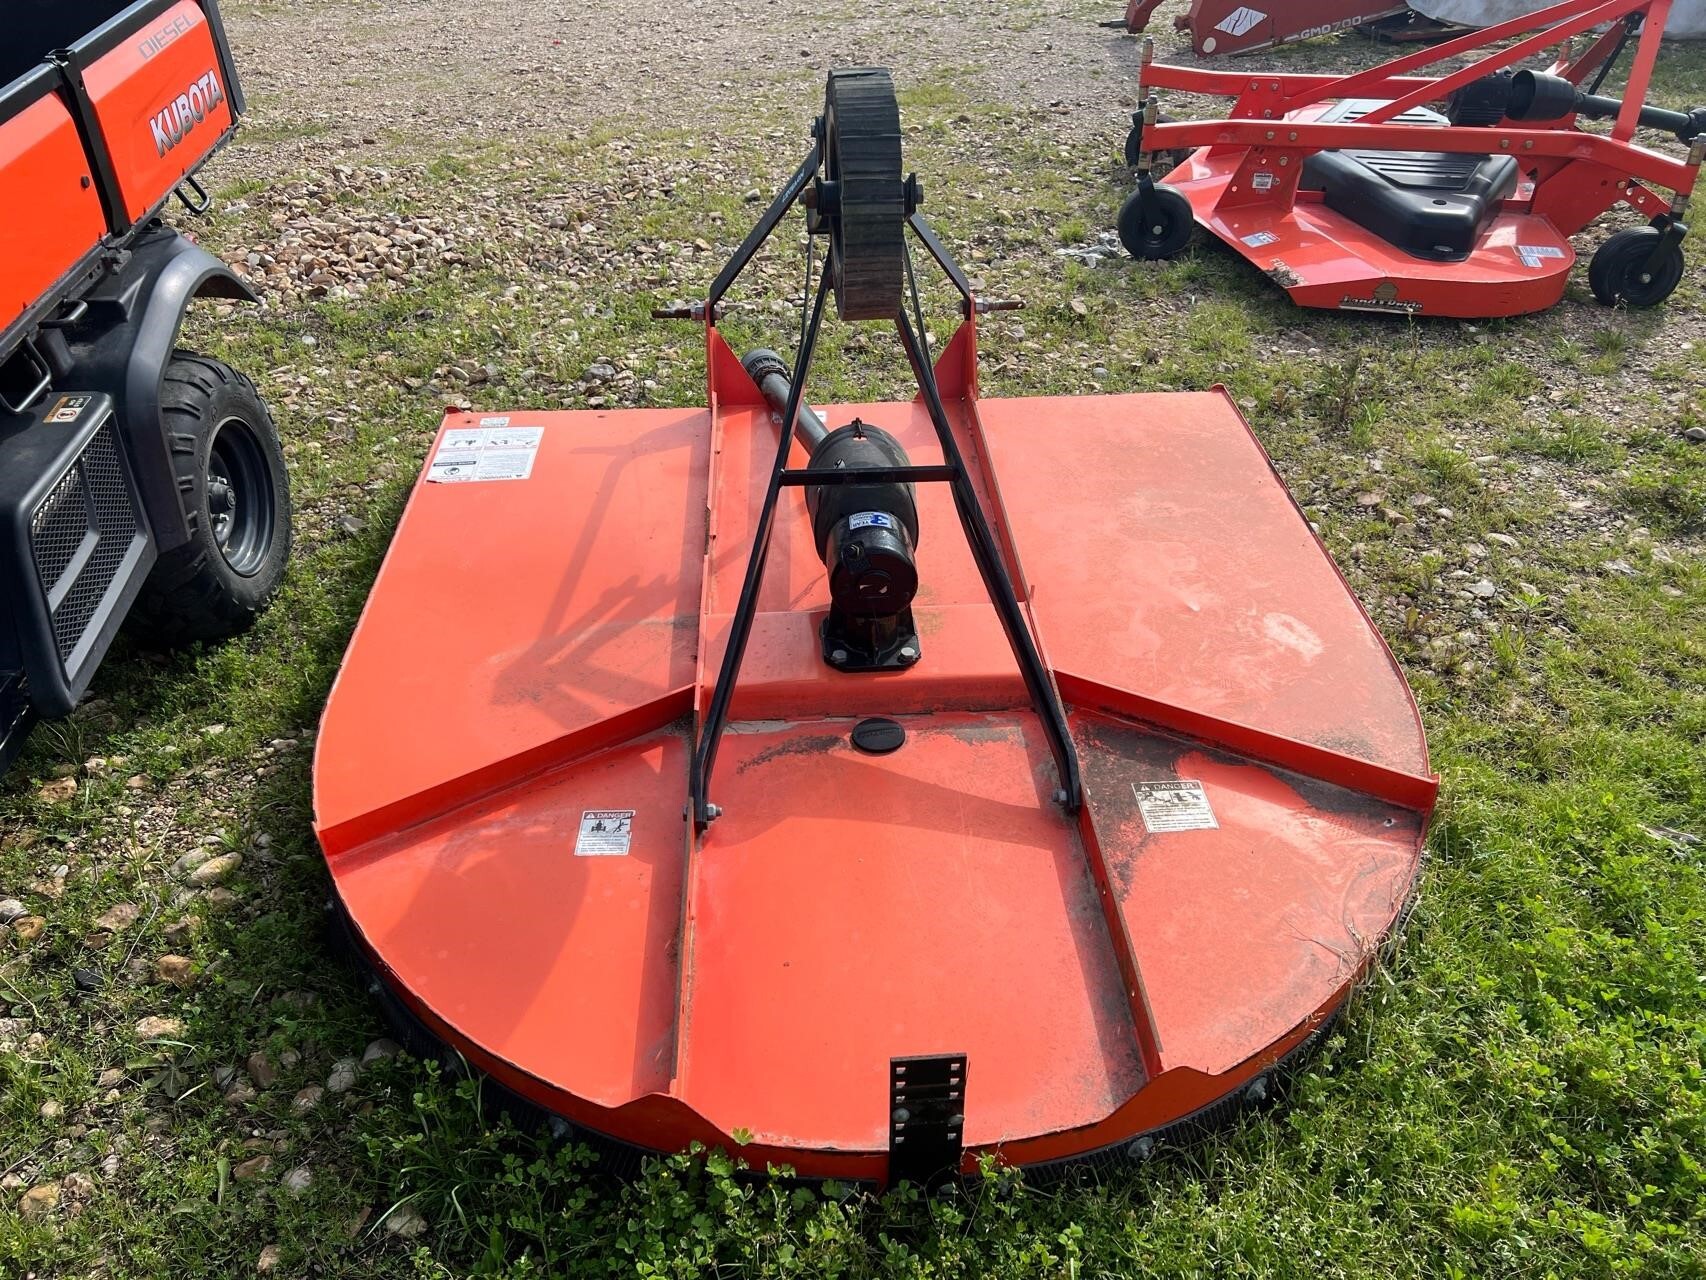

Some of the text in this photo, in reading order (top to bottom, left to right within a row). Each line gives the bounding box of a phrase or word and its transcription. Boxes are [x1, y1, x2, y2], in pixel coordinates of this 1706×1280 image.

[138, 13, 197, 59] DIESEL
[149, 68, 224, 158] KUBOTA
[1154, 782, 1194, 791] DANGER
